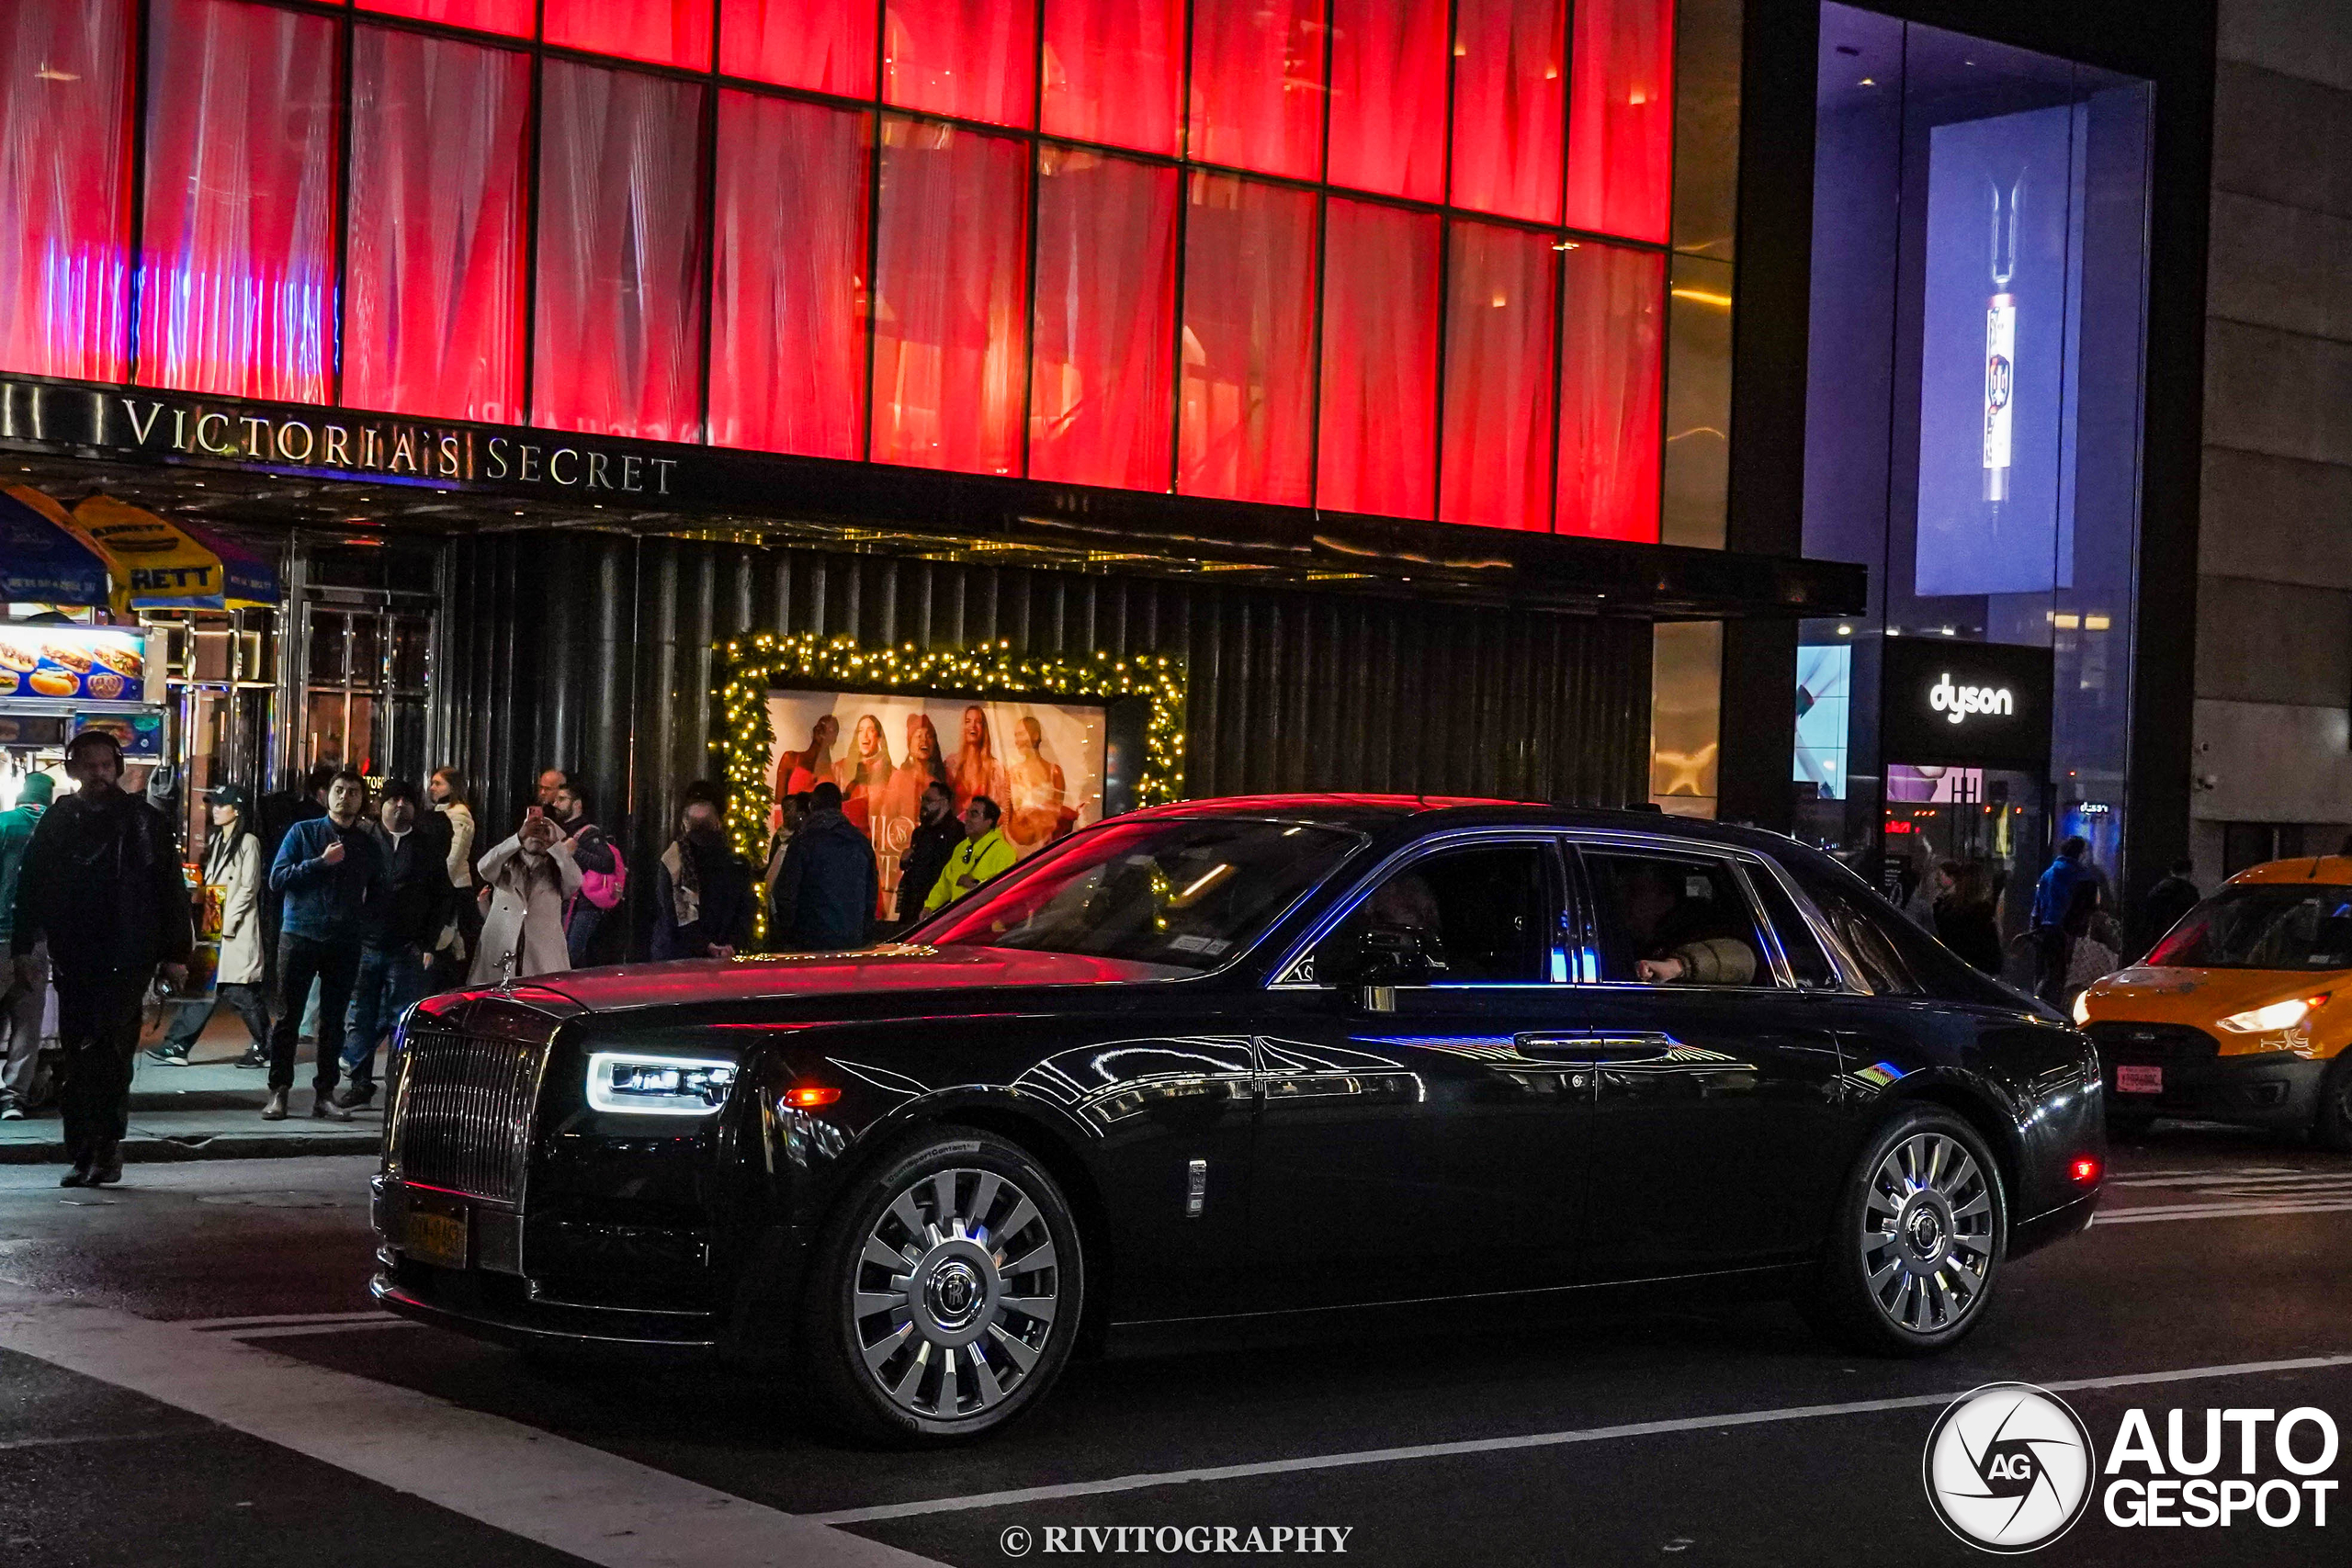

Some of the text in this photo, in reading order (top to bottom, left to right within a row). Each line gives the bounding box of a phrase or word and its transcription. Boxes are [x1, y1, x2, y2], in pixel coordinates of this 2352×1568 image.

[122, 399, 458, 475] VICTORIA'S
[487, 437, 678, 494] SECRET
[1929, 672, 2013, 724] dyson
